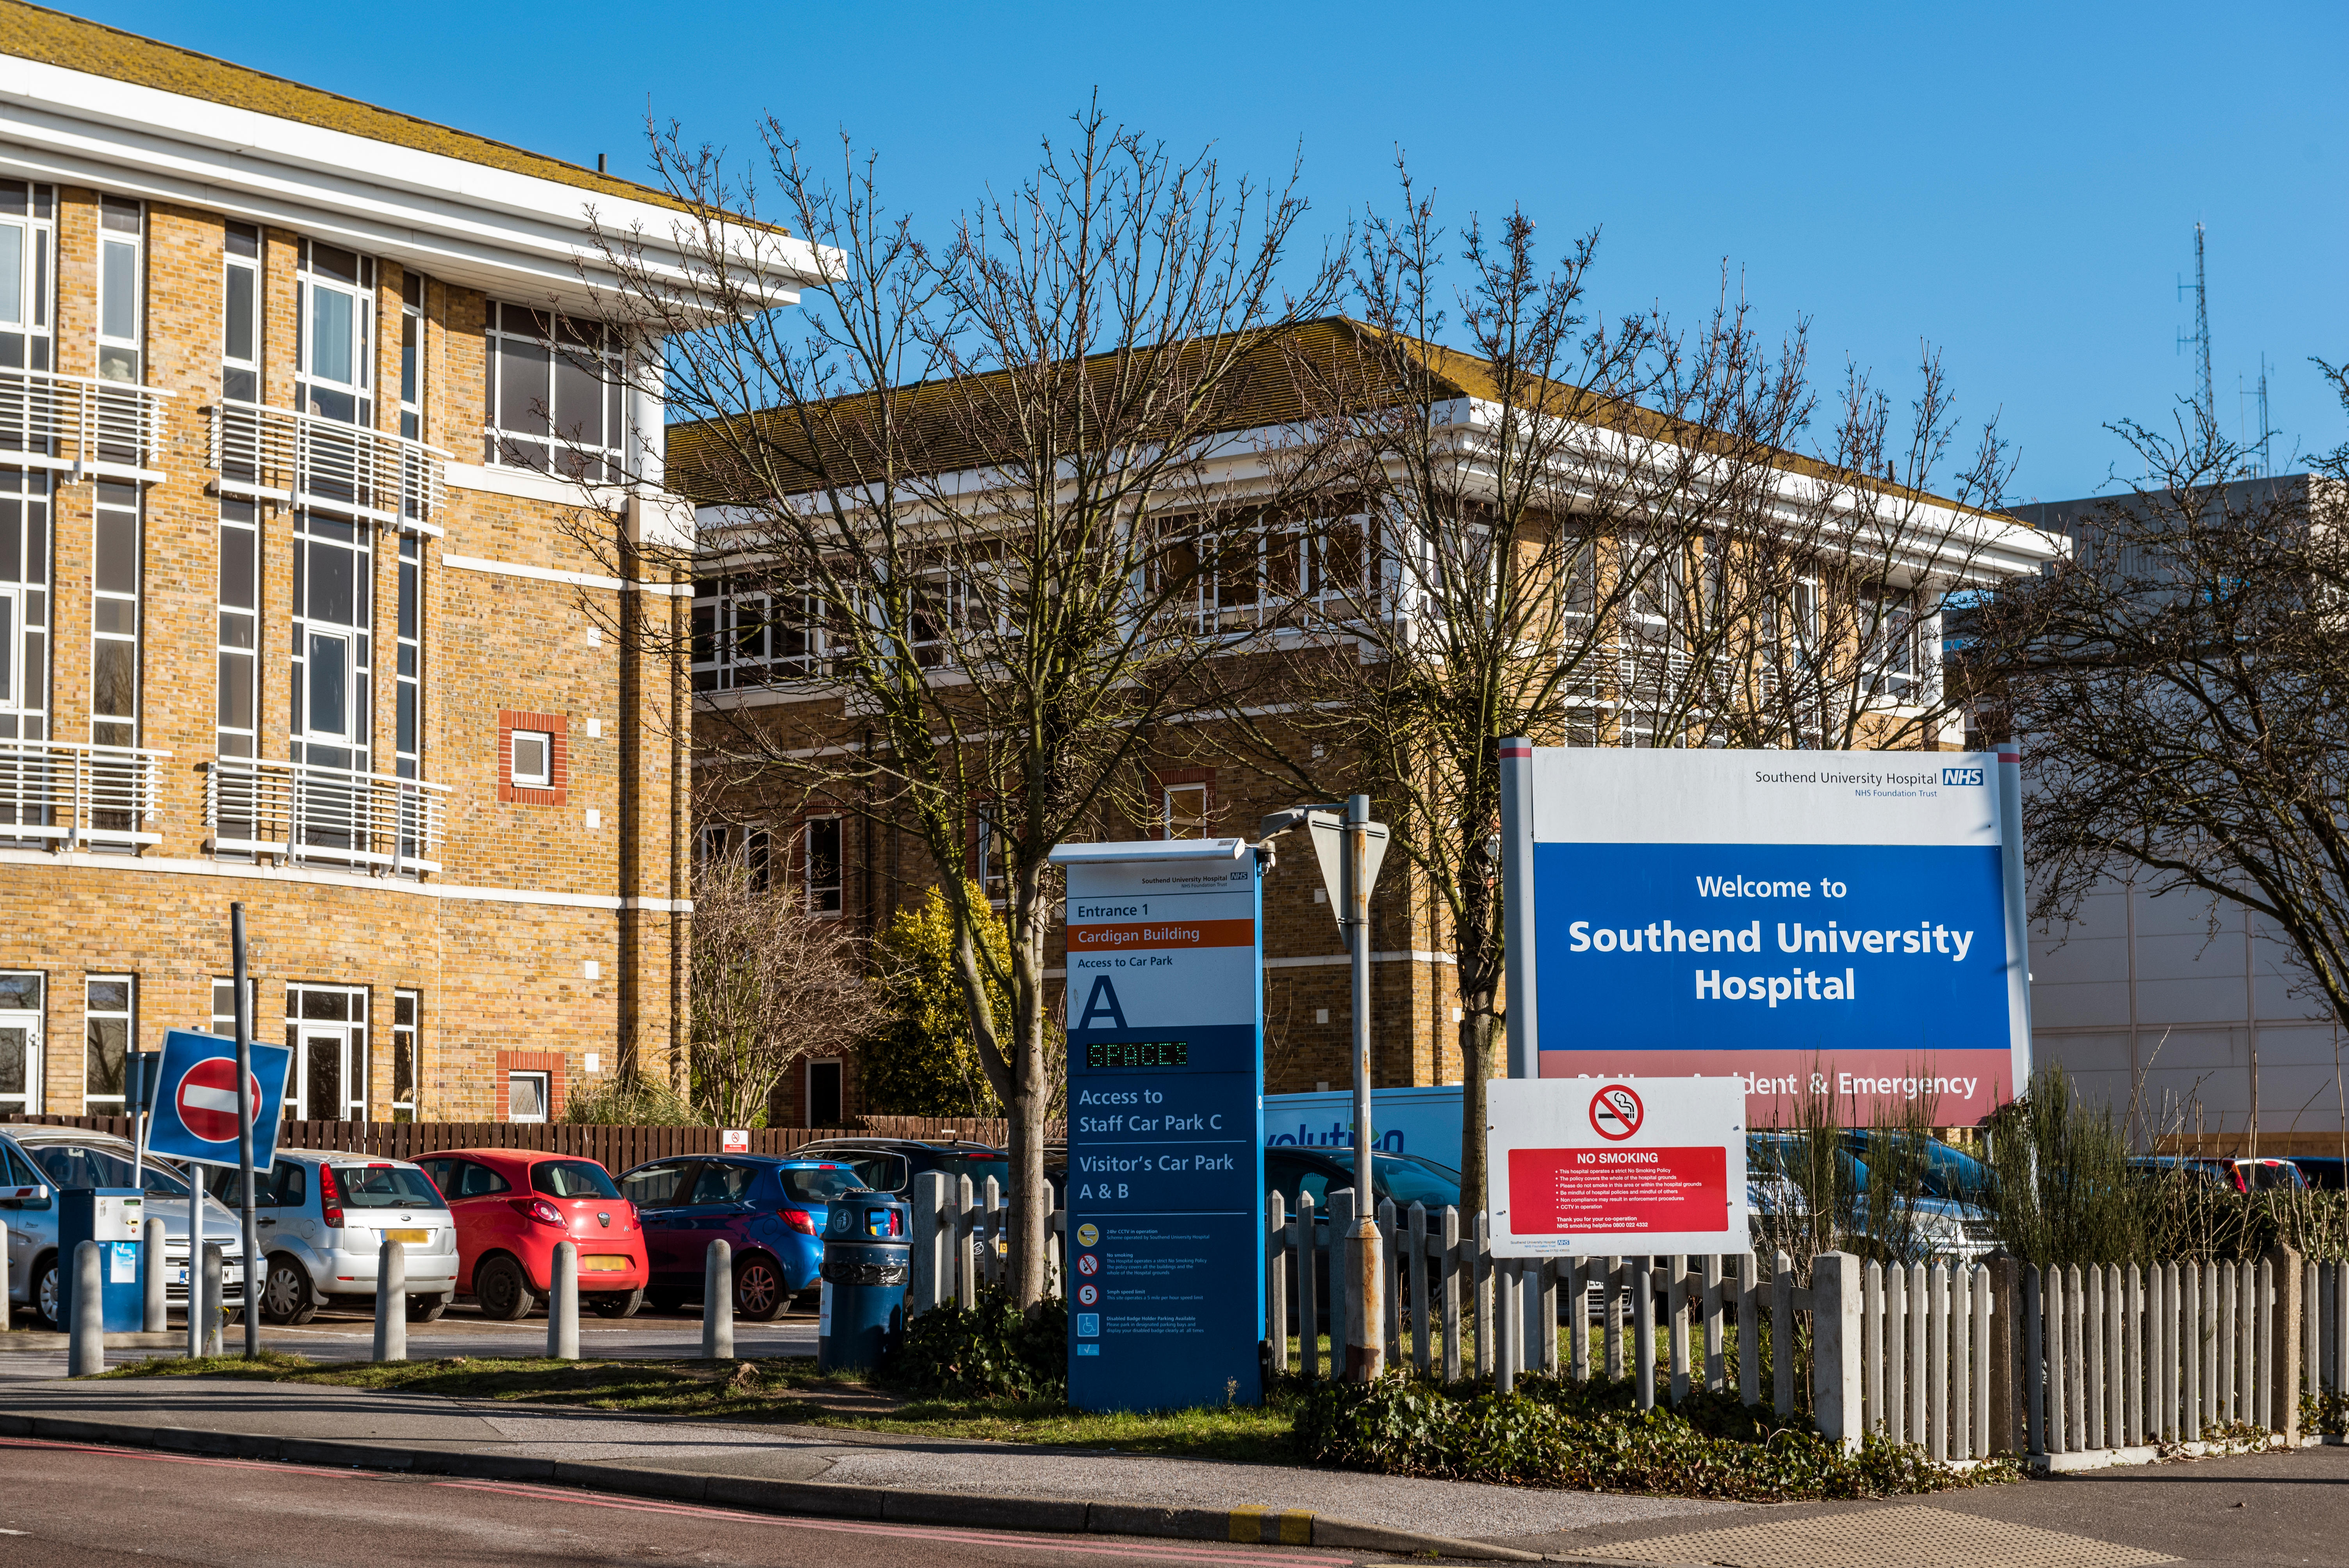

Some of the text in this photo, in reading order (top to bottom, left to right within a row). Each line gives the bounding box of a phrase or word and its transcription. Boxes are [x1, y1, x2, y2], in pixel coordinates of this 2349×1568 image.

[1756, 769, 1982, 787] Southend University Hospital NHS
[1696, 875, 1846, 898] Welcome to
[1078, 903, 1147, 917] Entrance 1
[1078, 927, 1199, 944] Cardigan Building
[1569, 920, 1974, 961] Southend University
[1078, 956, 1173, 968] Access to Car Park
[1696, 968, 1854, 1008] Hospital
[1078, 975, 1128, 1029] A
[1091, 1043, 1186, 1066] SPACES
[1810, 1073, 1829, 1094] &
[1839, 1073, 1977, 1099] Emergency
[1079, 1089, 1162, 1105] Access to
[1258, 1095, 1262, 1110] 8
[1080, 1114, 1221, 1132] Staff Car Park C
[1080, 1154, 1233, 1172] Visitor's Car Park
[1577, 1153, 1658, 1164] NO SMOKING
[1080, 1184, 1128, 1199] A & B
[1085, 1290, 1092, 1300] 5
